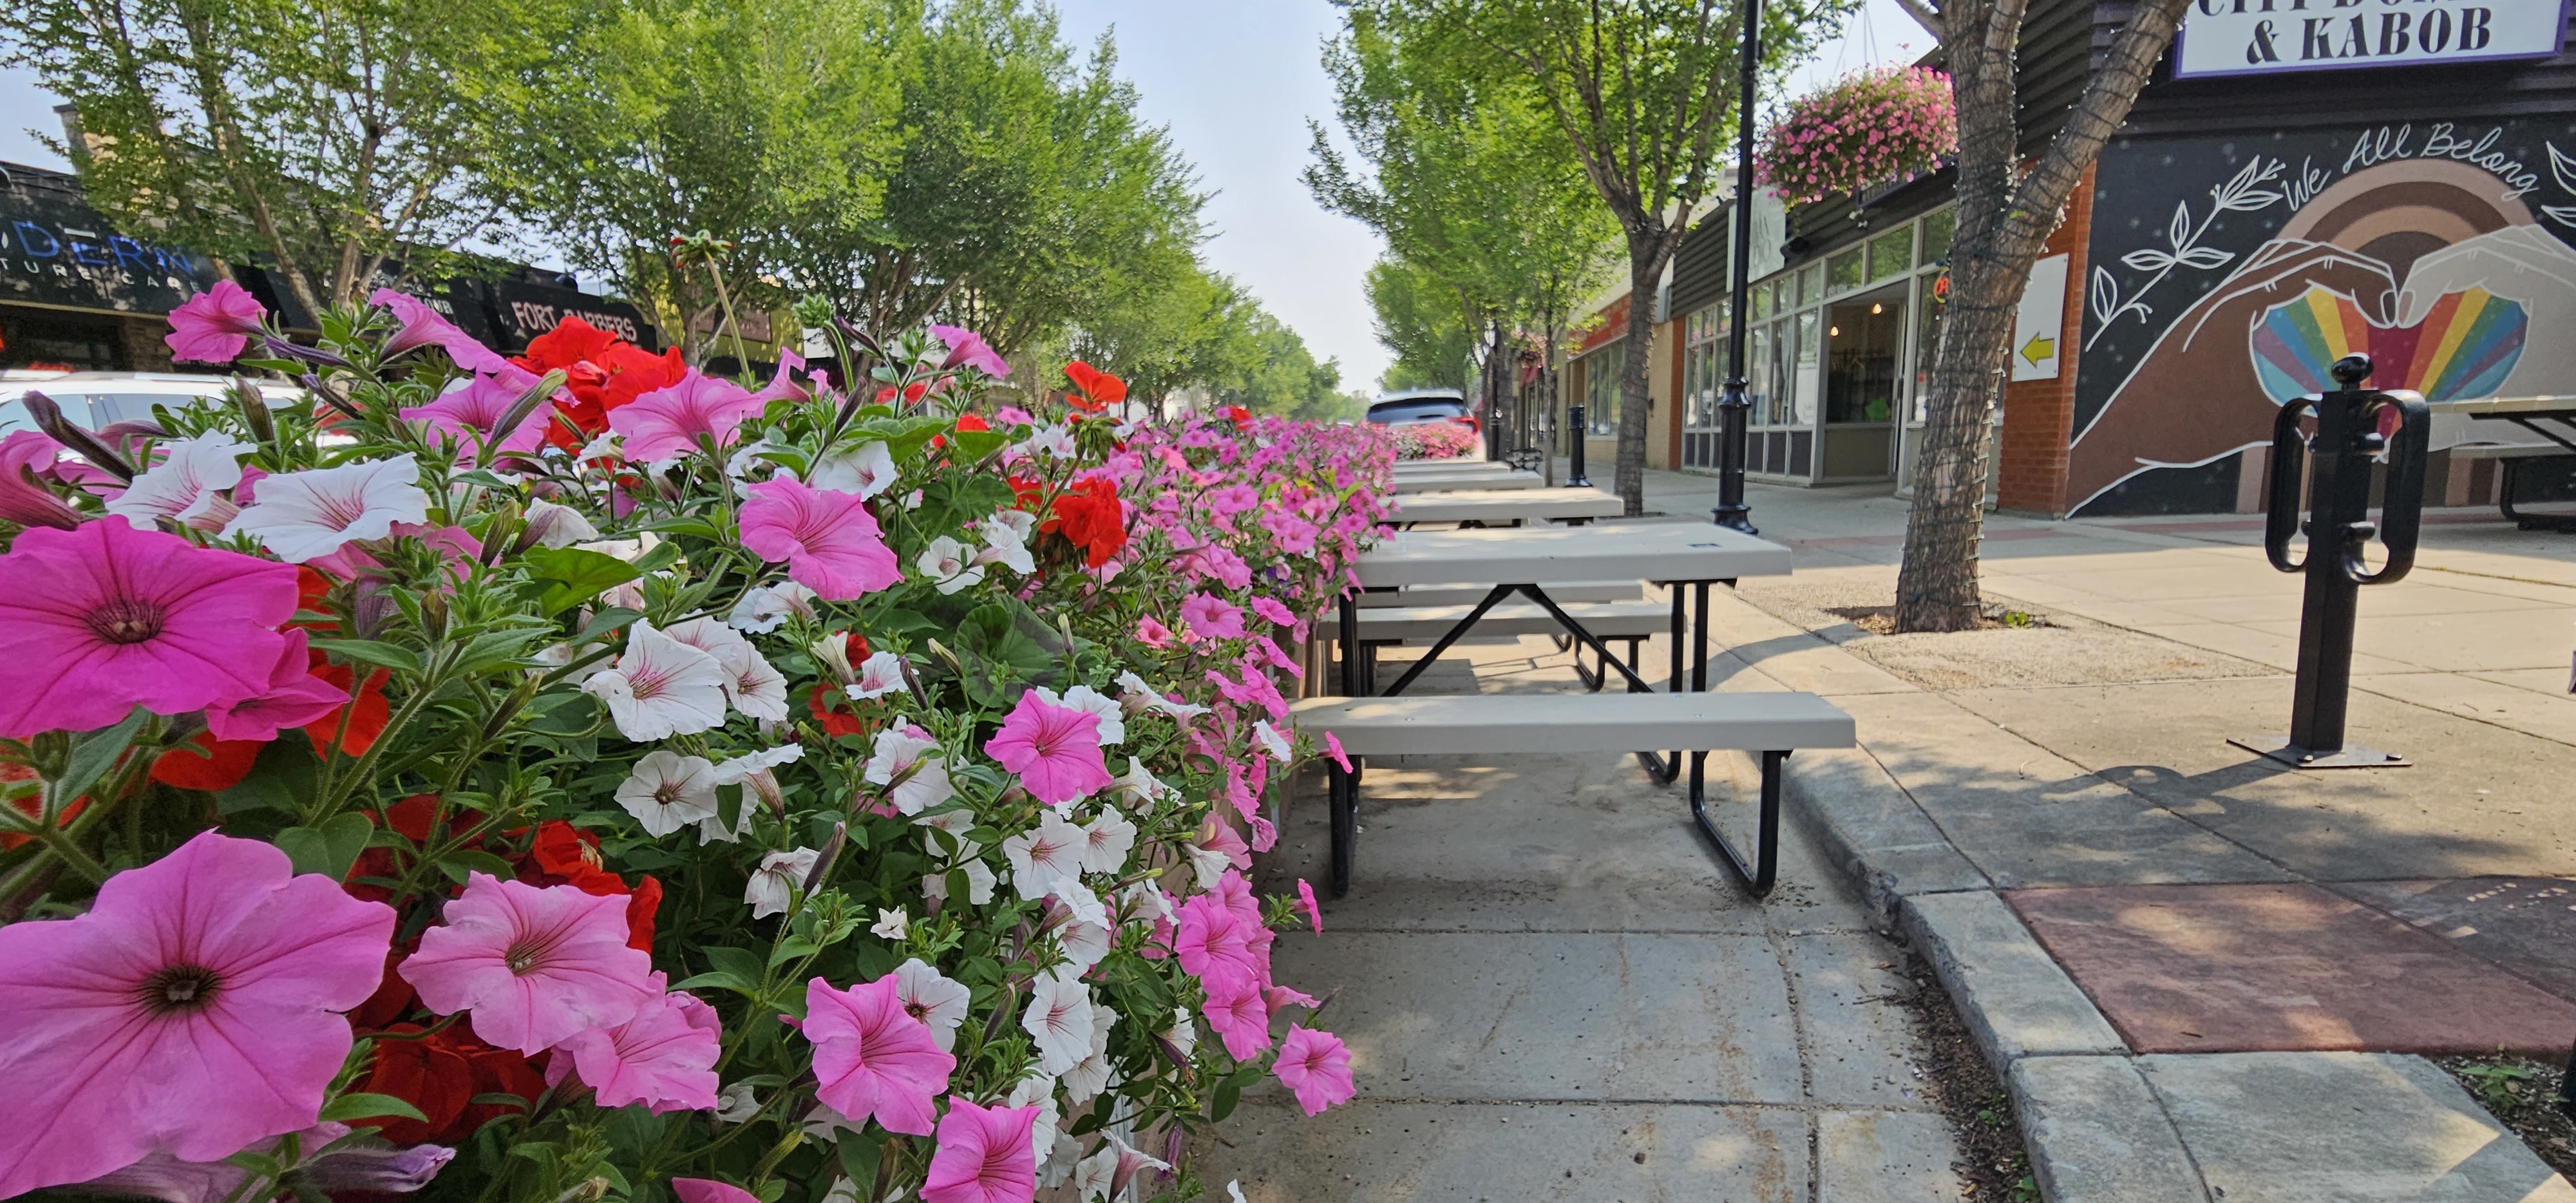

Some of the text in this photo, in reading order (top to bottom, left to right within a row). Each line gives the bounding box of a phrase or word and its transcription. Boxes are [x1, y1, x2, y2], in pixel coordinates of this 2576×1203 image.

[2246, 7, 2492, 64] & KABOB
[2280, 122, 2539, 211] We All Belong
[511, 301, 638, 343] FORT RBERS
